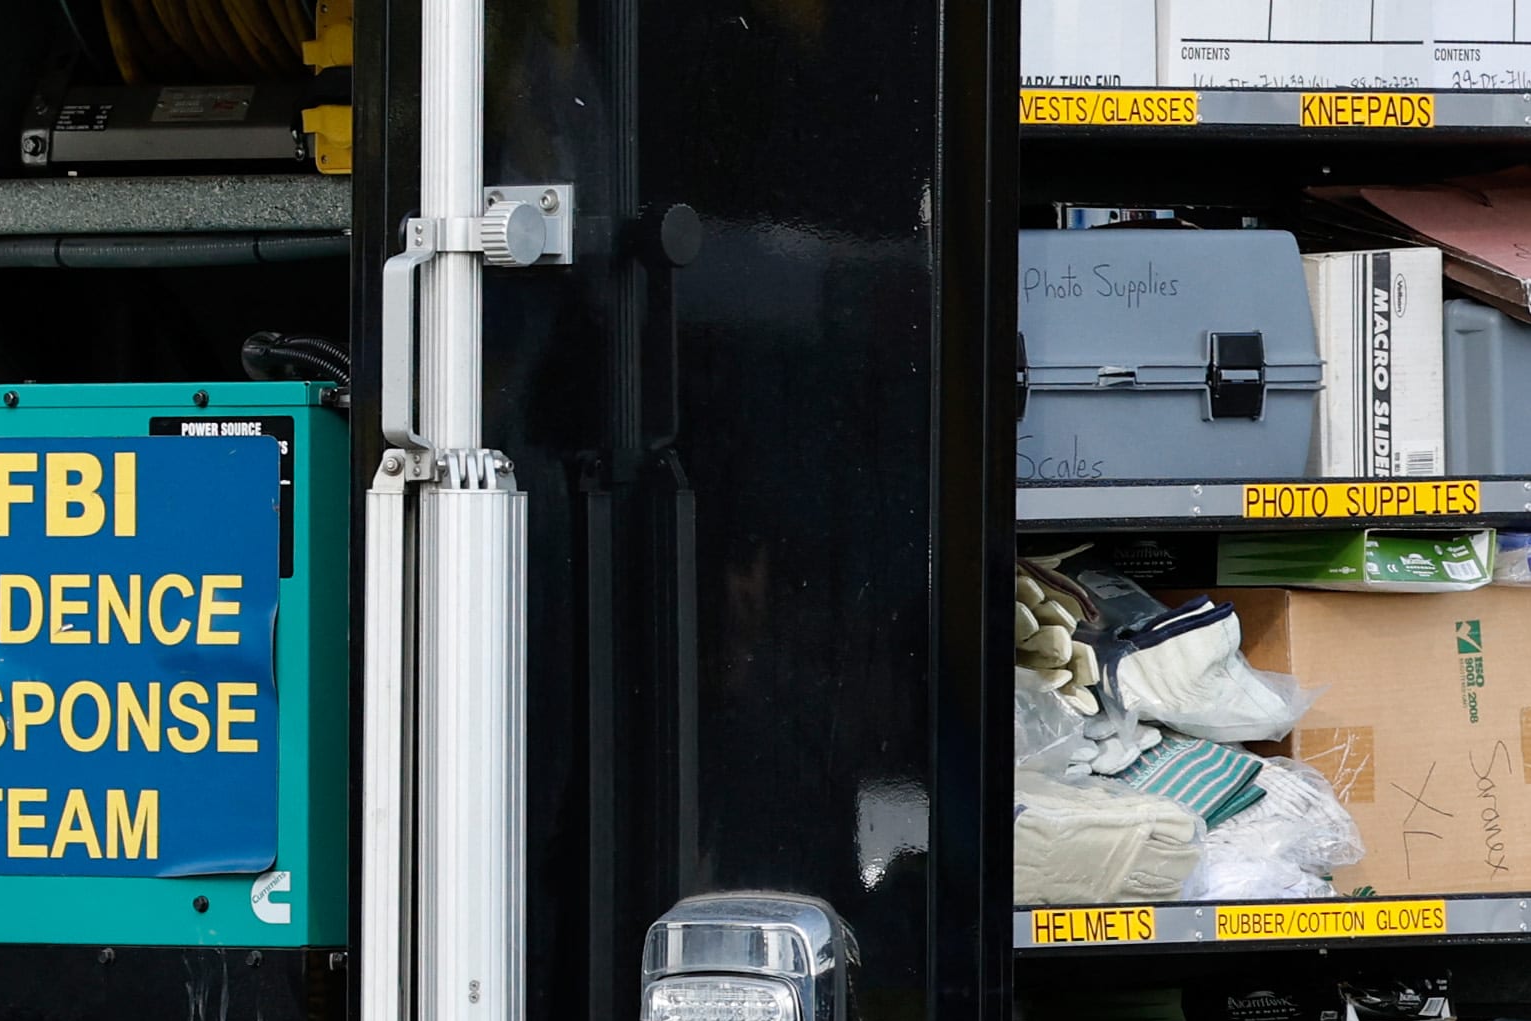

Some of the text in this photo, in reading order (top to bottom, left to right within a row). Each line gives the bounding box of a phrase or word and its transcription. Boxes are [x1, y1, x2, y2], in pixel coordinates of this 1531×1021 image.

[1180, 46, 1230, 61] CONTENTS
[1434, 47, 1481, 62] CONTENTS
[1020, 94, 1194, 123] VESTS/GLASSES
[1301, 95, 1431, 126] KNEEPADS
[1023, 261, 1180, 309] Photo Supplies
[1373, 286, 1390, 391] MACRO
[181, 422, 262, 436] POWER SOURCE
[1016, 434, 1103, 480] Scales
[1245, 484, 1477, 517] PHOTO SUPPLIES
[1474, 656, 1485, 688] ISO
[252, 871, 287, 904] Cummins
[1035, 909, 1153, 943] HELMETS
[1218, 908, 1444, 935] RUBBER/COTTON GLOVES
